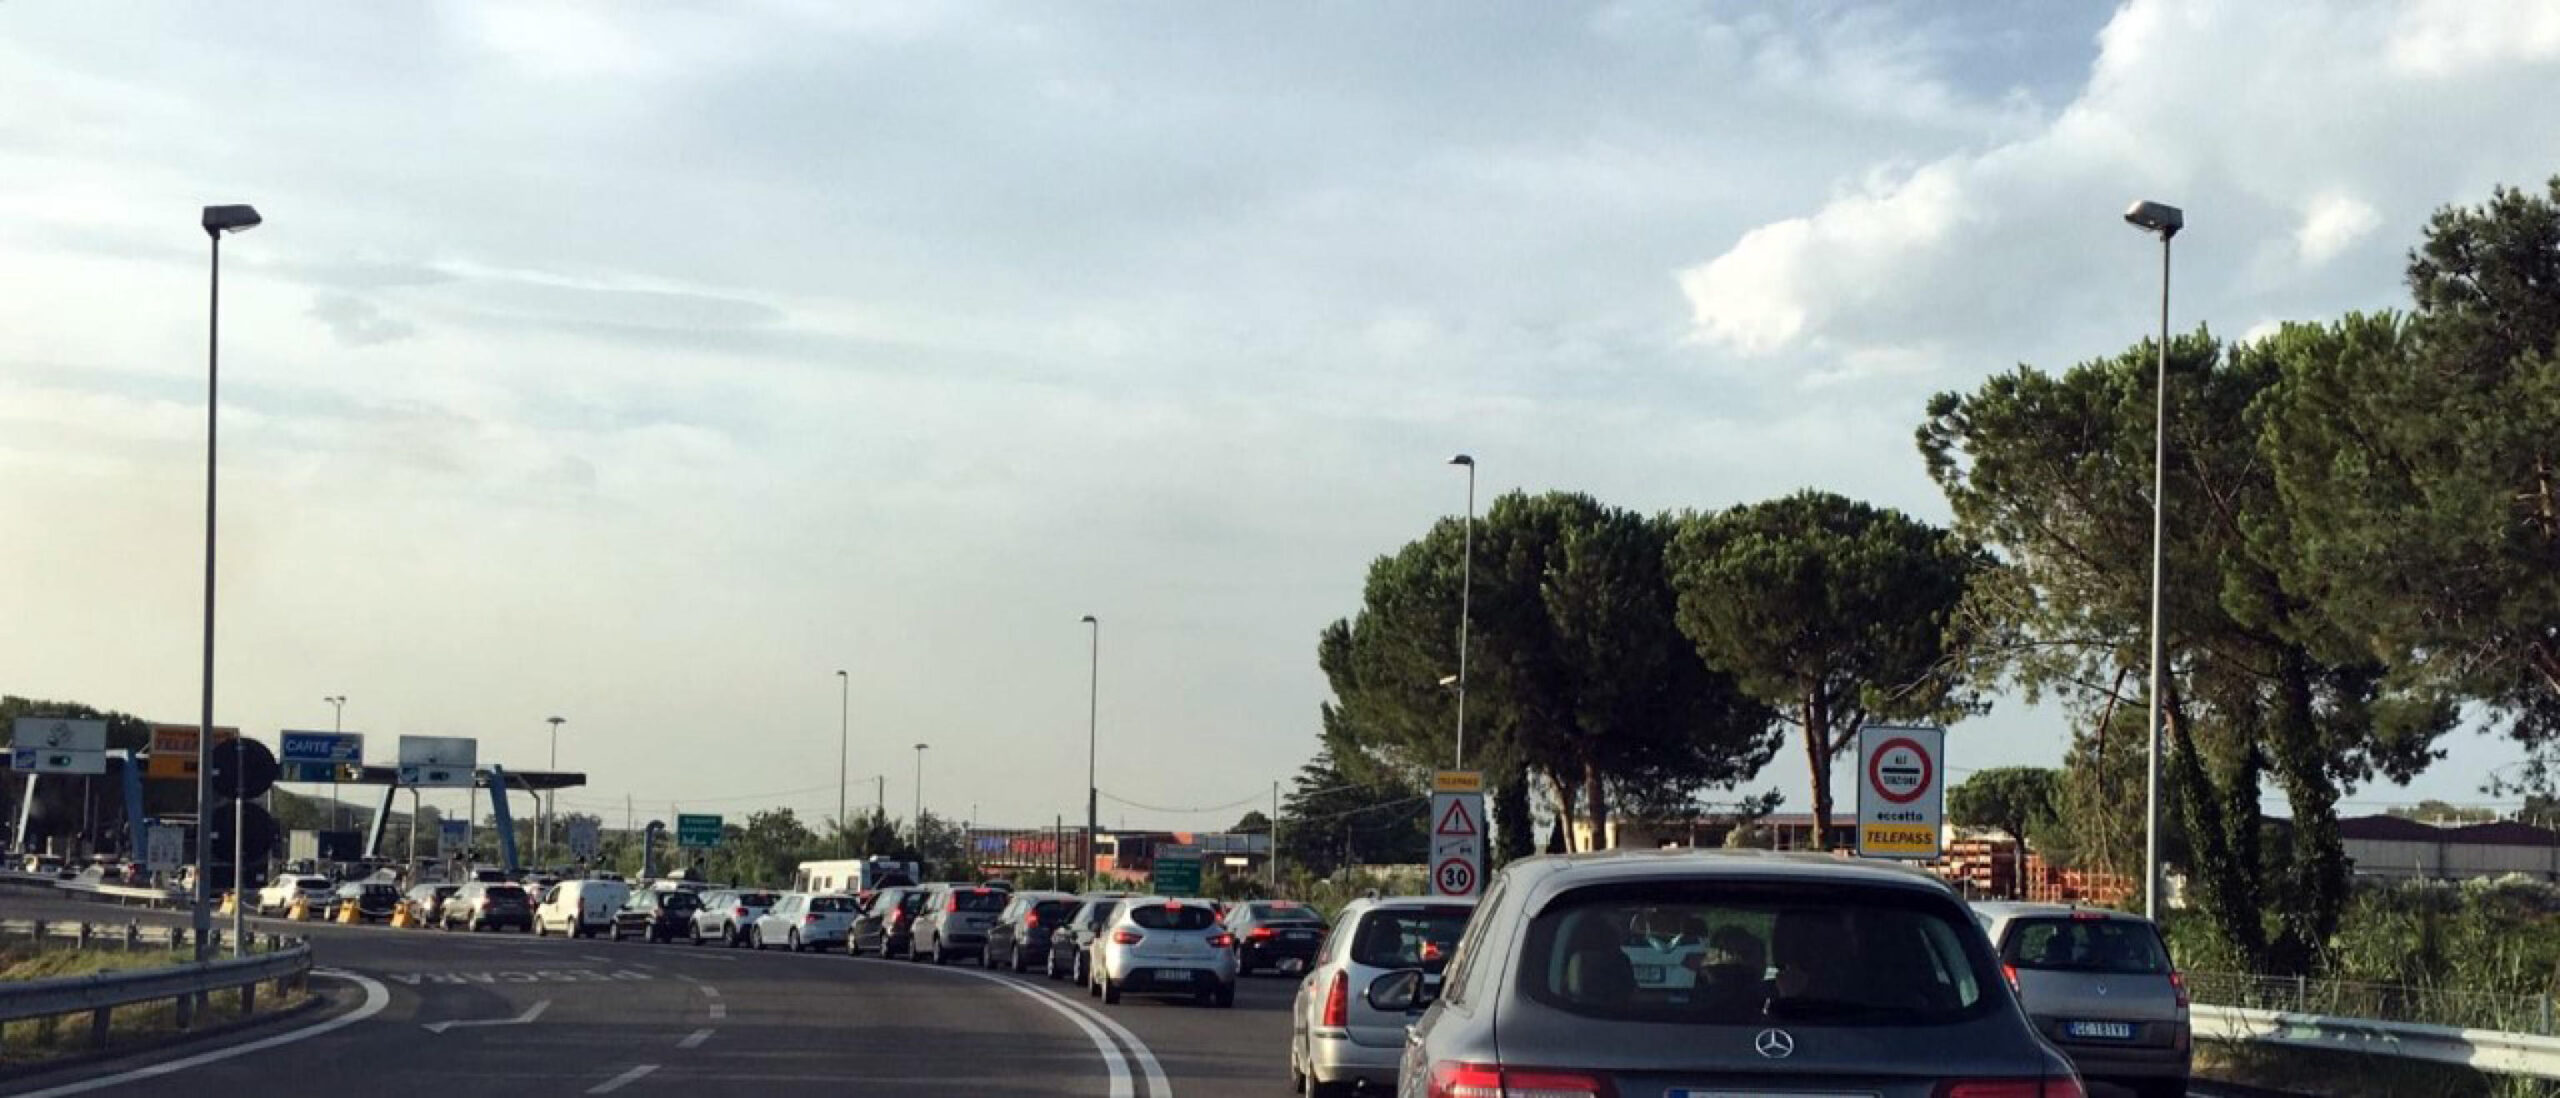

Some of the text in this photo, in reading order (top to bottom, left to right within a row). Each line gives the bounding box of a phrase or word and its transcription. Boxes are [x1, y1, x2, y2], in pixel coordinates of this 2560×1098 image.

[285, 739, 330, 754] CARTE
[1877, 811, 1924, 821] eccetto
[1867, 831, 1935, 845] TELEPASS
[1445, 868, 1467, 886] 30
